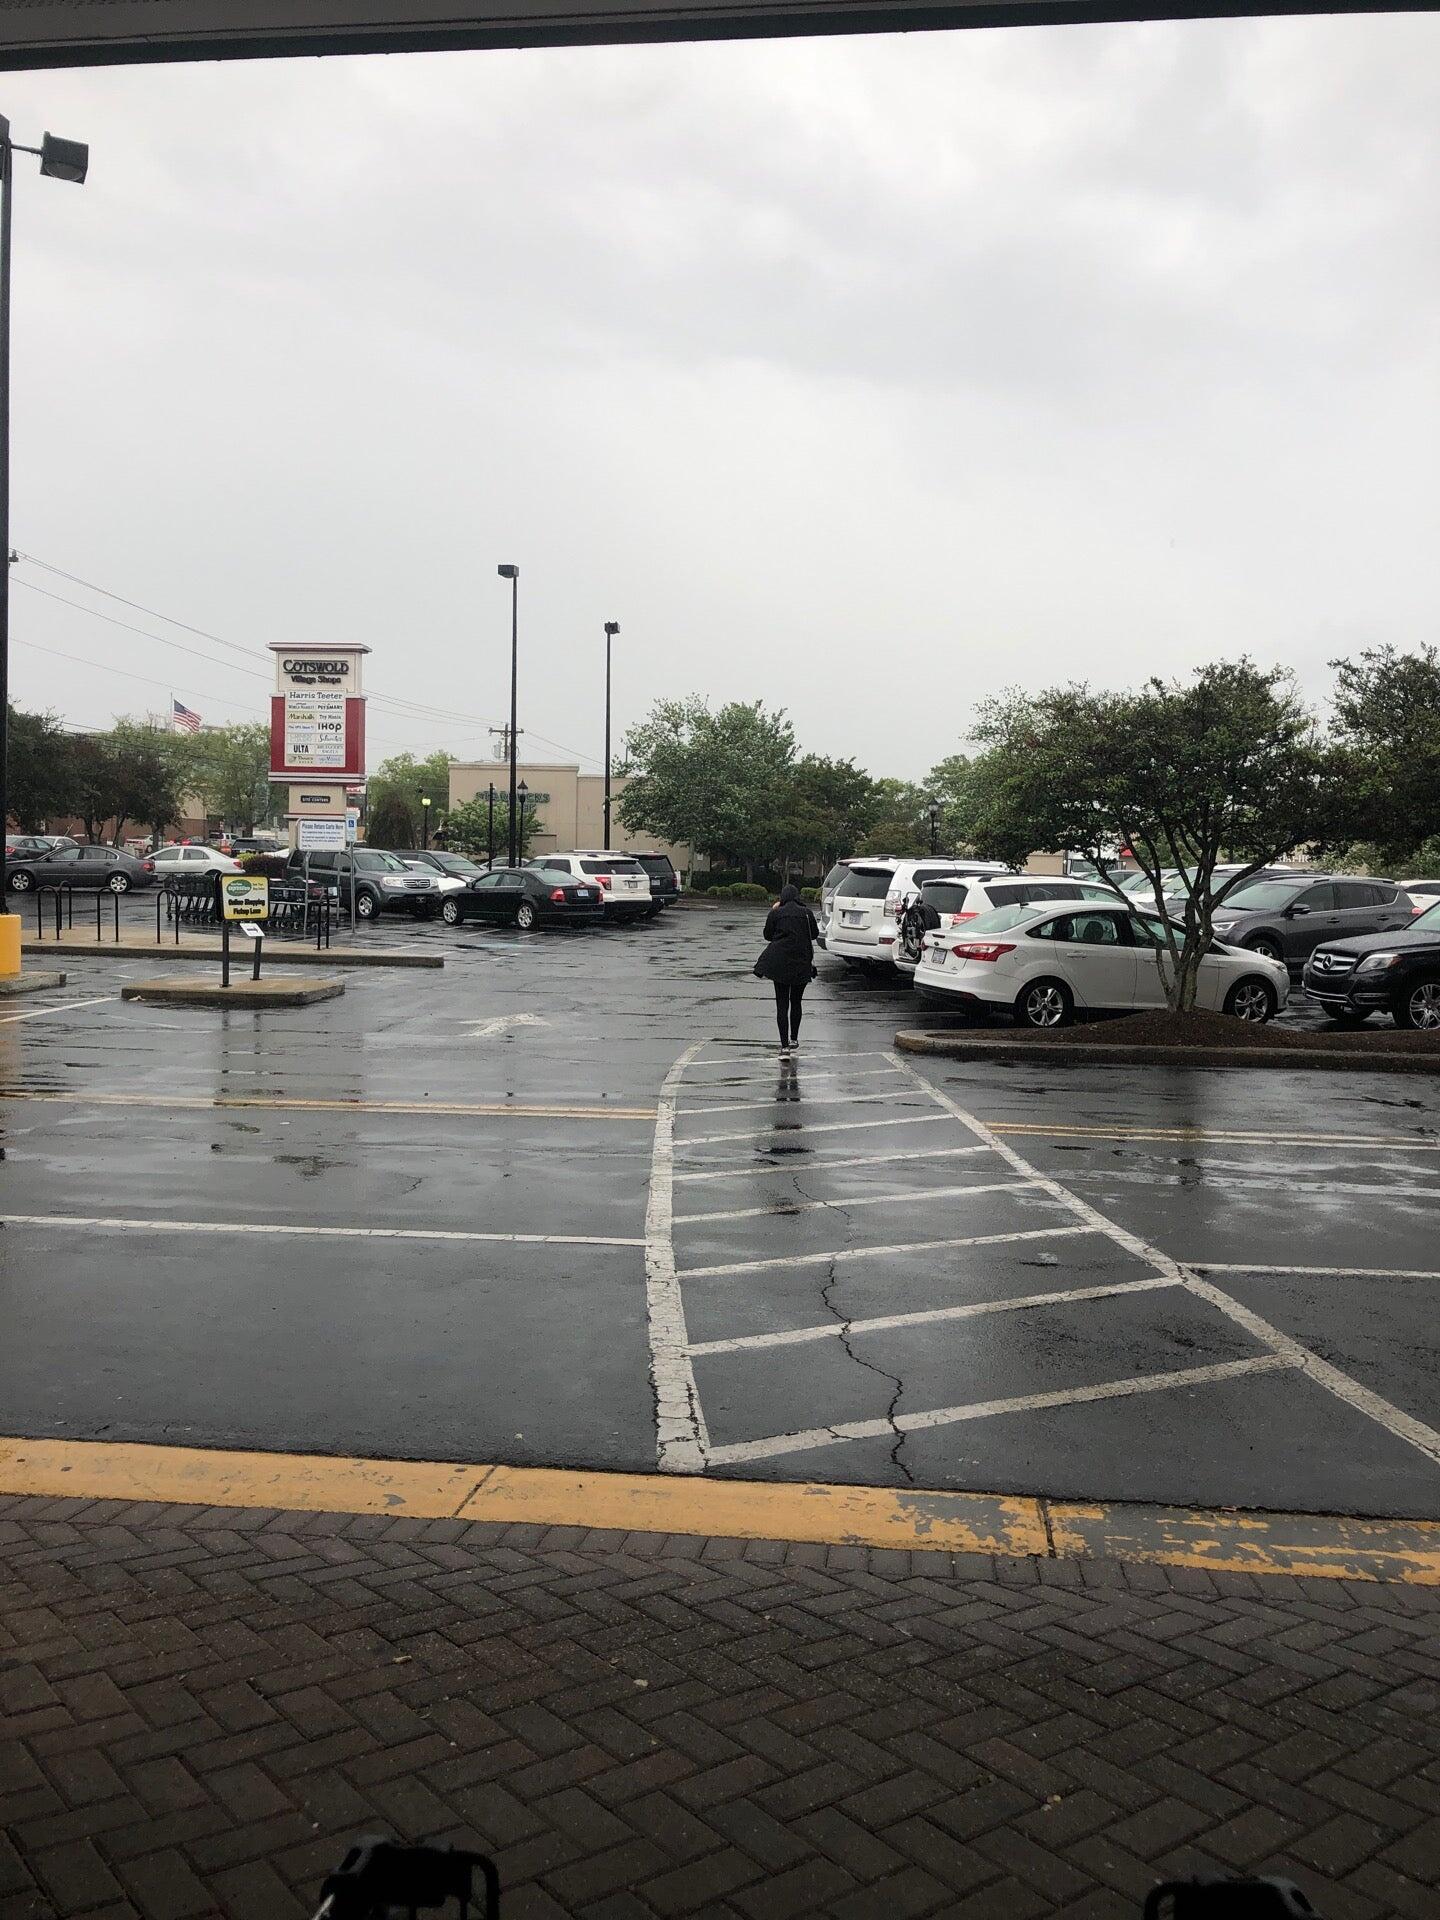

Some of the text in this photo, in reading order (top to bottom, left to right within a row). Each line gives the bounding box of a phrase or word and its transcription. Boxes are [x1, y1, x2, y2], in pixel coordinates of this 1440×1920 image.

[283, 660, 349, 674] COTSWOLD
[291, 675, 342, 685] Village Shops
[289, 691, 343, 699] Harris Teeter
[293, 744, 309, 753] ULTA
[228, 898, 265, 907] Online Shopping
